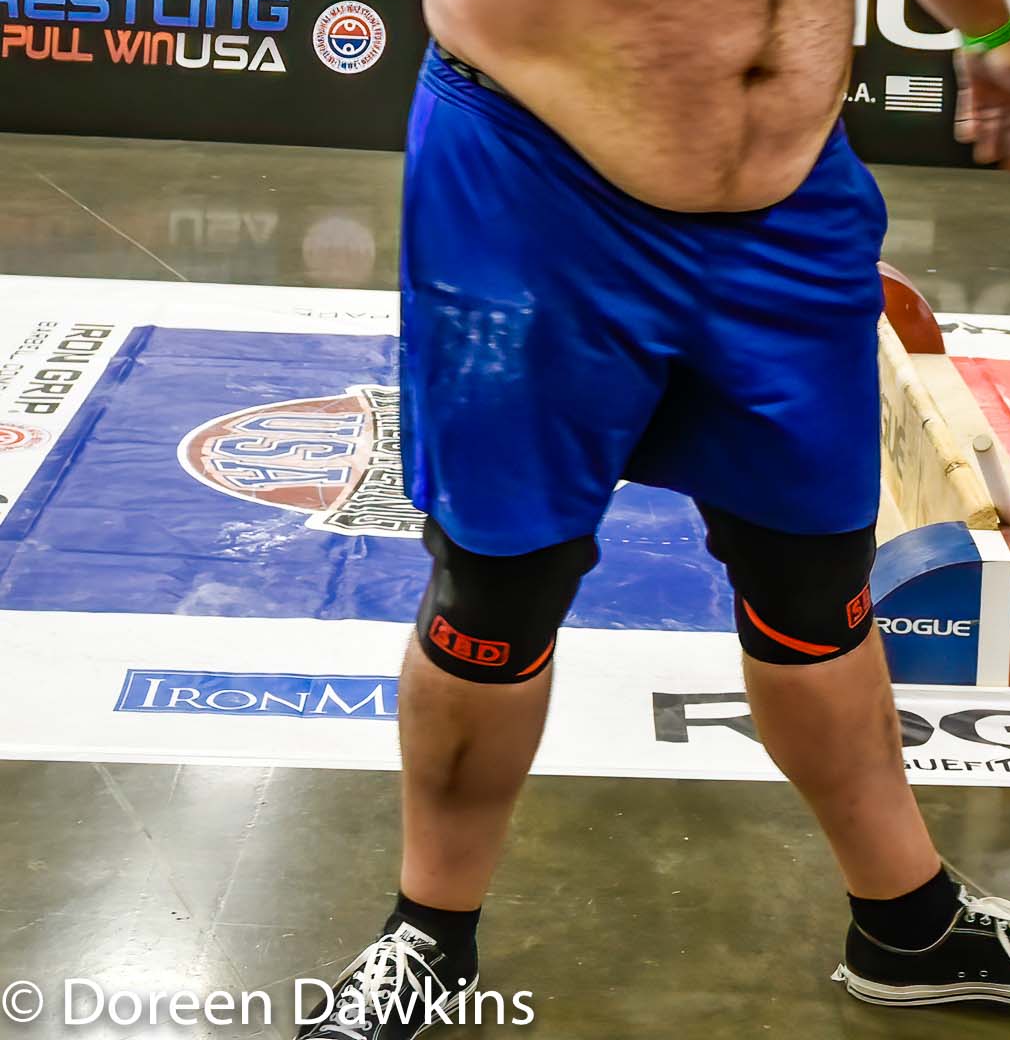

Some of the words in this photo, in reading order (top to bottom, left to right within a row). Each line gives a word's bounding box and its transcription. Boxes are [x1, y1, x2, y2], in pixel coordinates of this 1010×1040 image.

[2, 24, 93, 62] PULL
[46, 323, 115, 363] IRON
[14, 369, 82, 415] GRIP
[873, 617, 970, 637] ROGUE
